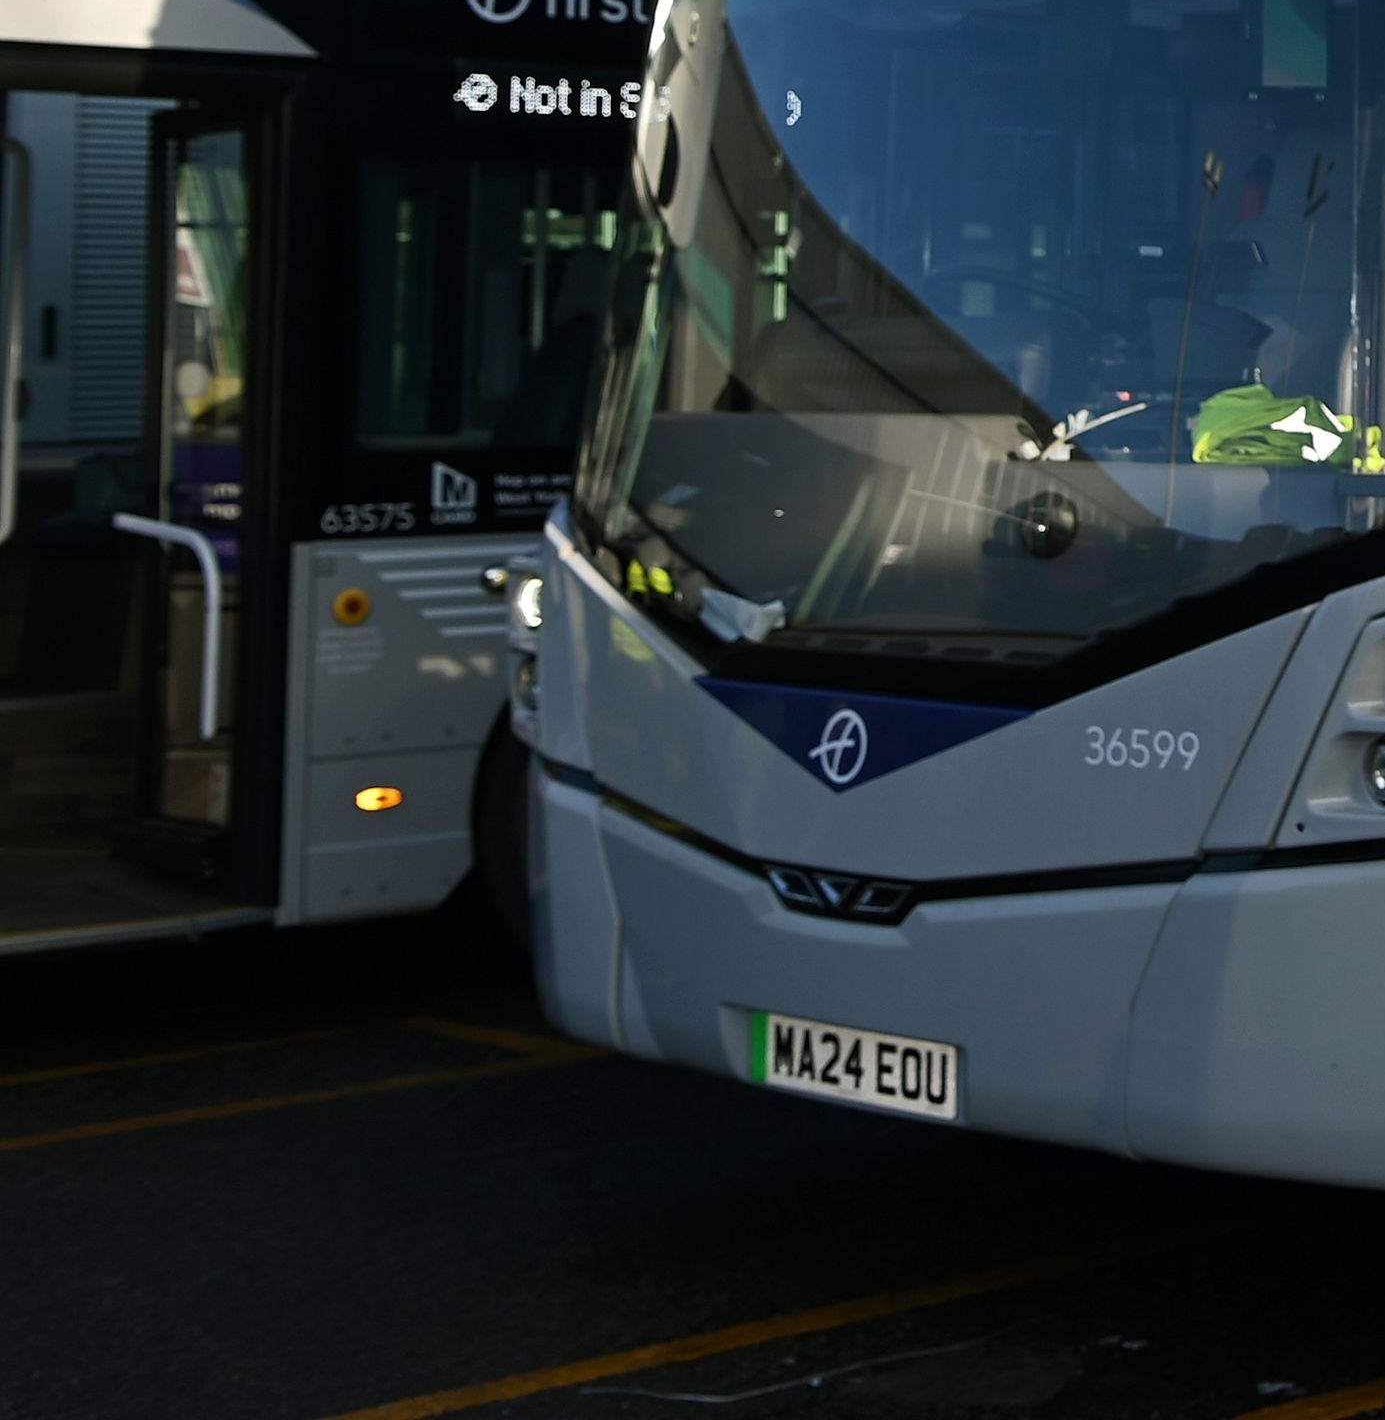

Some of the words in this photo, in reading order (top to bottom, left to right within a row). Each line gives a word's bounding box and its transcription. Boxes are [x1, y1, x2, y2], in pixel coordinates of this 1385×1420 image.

[509, 75, 572, 115] Not
[580, 78, 611, 117] in
[320, 501, 416, 534] 63575
[1083, 725, 1201, 771] 36599
[774, 1022, 865, 1089] MA24
[876, 1041, 948, 1105] EOU
